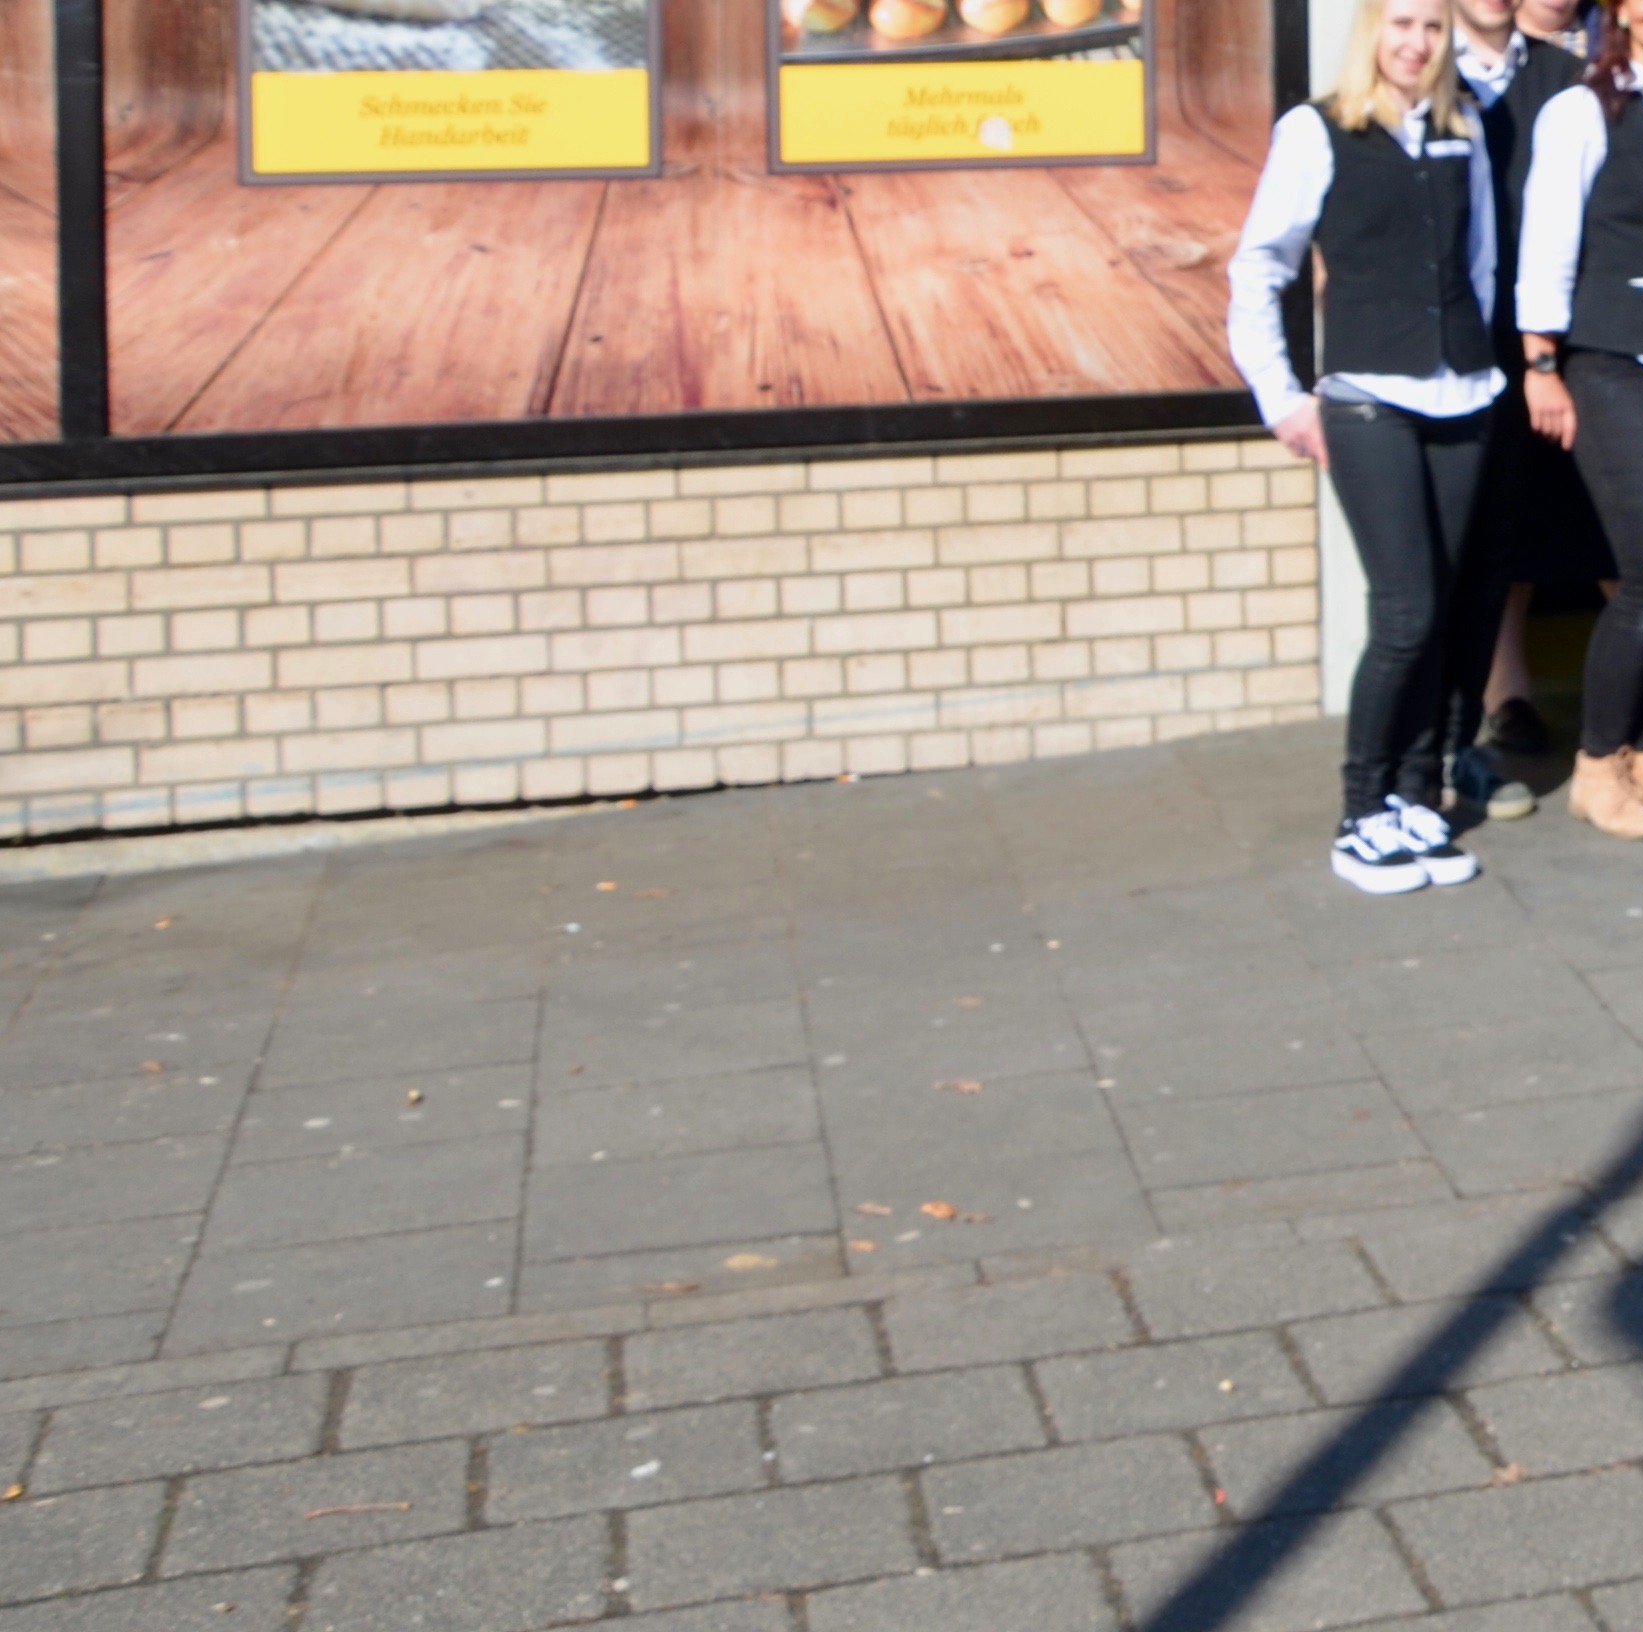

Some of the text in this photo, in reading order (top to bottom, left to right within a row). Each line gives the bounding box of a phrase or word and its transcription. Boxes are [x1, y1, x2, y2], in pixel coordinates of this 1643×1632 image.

[357, 92, 548, 118] Schmecken Sie
[902, 83, 1024, 108] Mehrmals
[379, 122, 531, 148] Handarbeit
